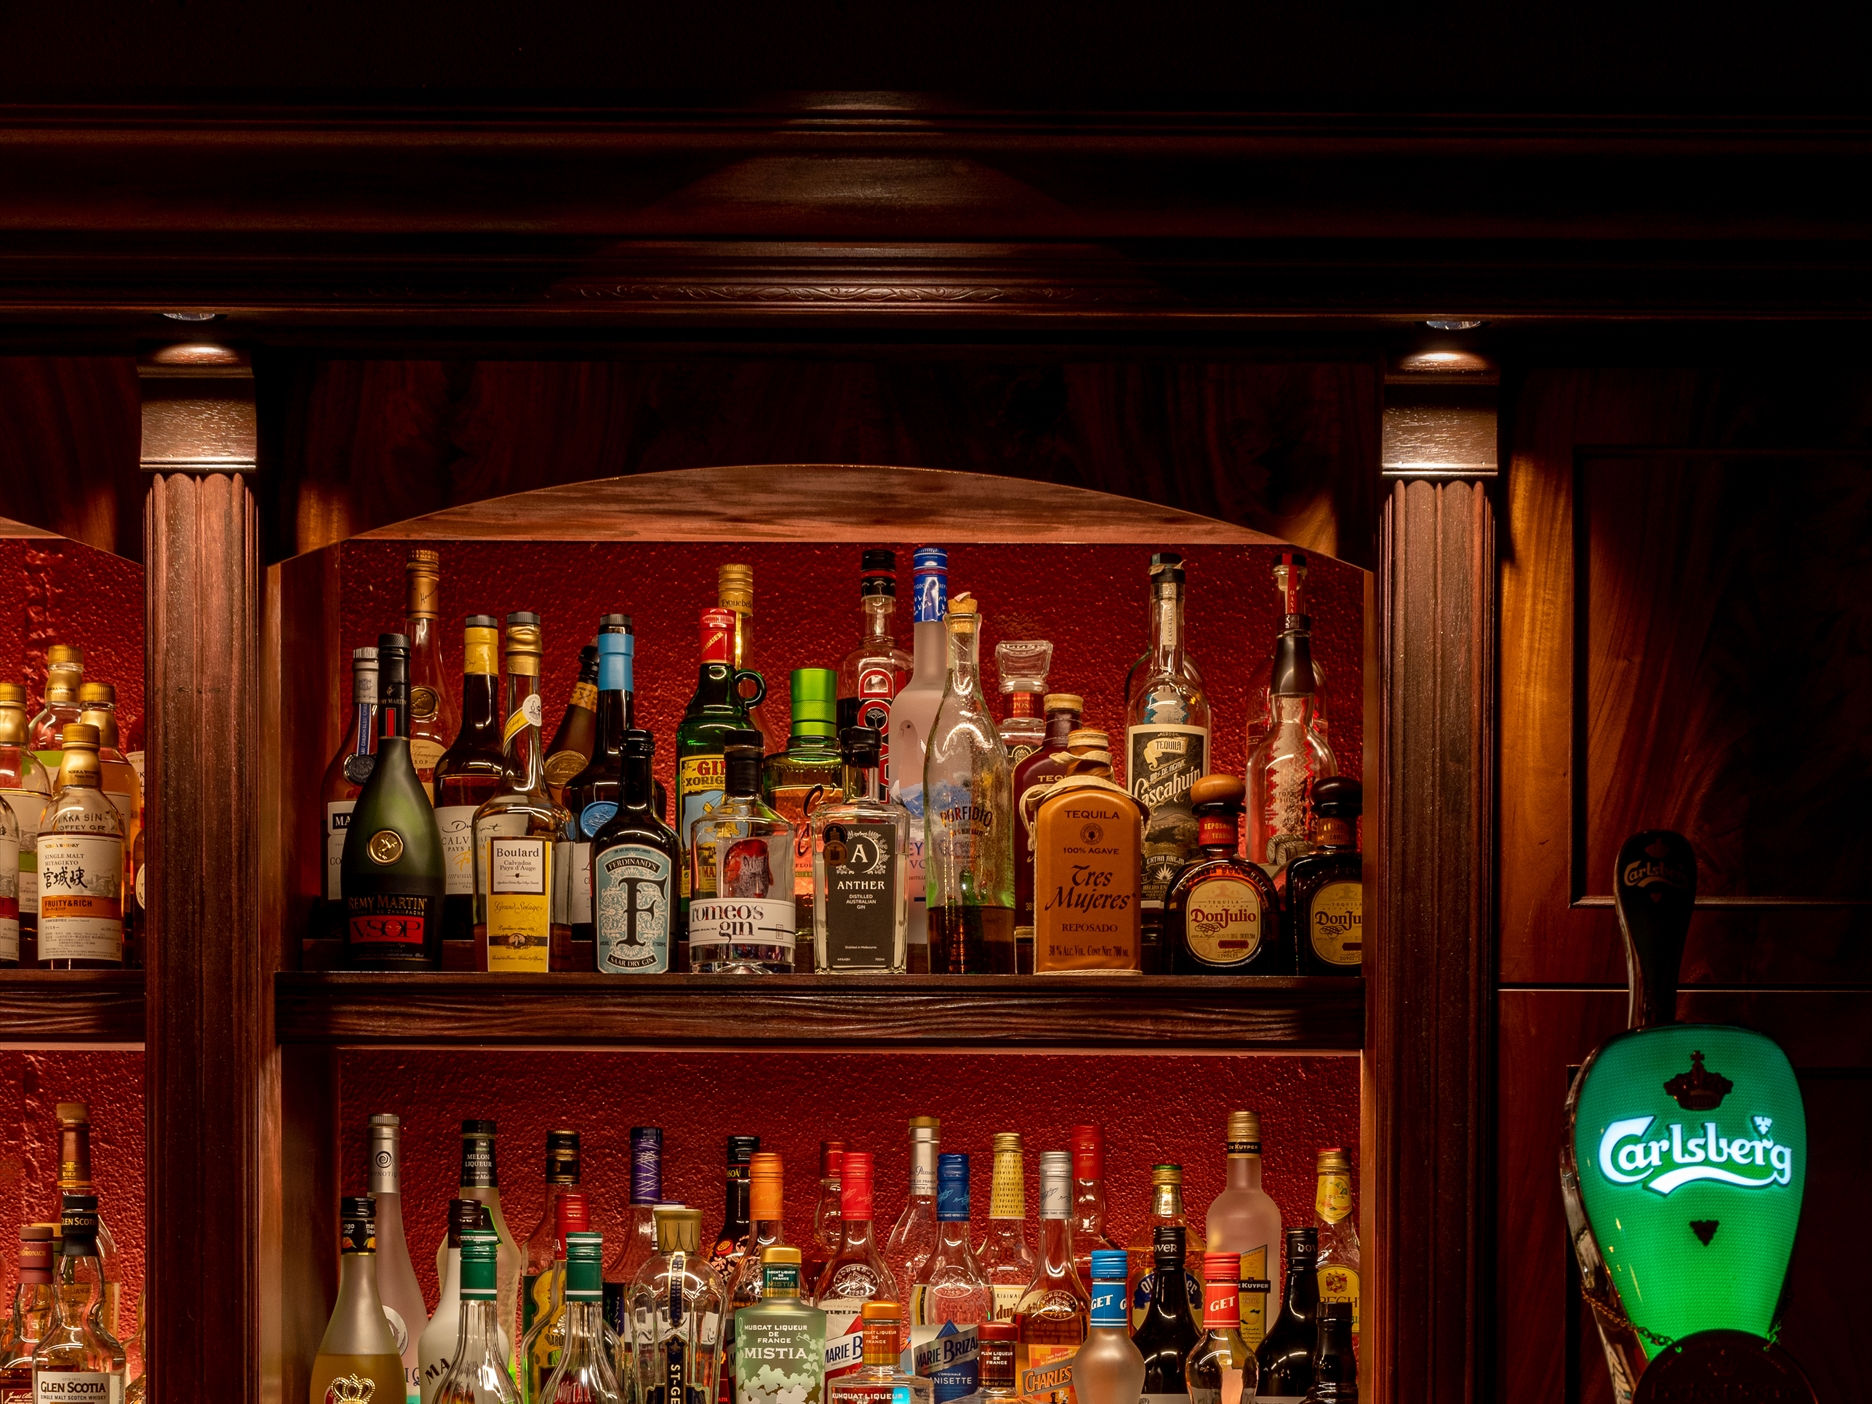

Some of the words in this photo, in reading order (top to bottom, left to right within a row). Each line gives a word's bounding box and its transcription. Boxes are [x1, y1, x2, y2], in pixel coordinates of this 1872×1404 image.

[1155, 740, 1182, 751] TEQUILA
[685, 776, 726, 787] XORIG
[1065, 810, 1120, 820] TEQUILA
[496, 848, 540, 858] Boulard
[1088, 847, 1120, 855] AGAVE
[608, 858, 658, 870] FERDINAND'S
[1070, 864, 1113, 887] Tres
[1624, 860, 1688, 888] Carlsberg
[837, 881, 886, 890] ANTHER
[377, 895, 426, 910] MARTIN
[1044, 886, 1131, 913] Mujeres
[616, 874, 668, 948] F
[691, 904, 765, 922] romeo's
[718, 921, 755, 943] gin
[1062, 923, 1118, 933] REPOSADO
[610, 956, 626, 965] SAAR
[627, 959, 641, 967] DRY
[641, 957, 654, 966] GIN
[1598, 1114, 1794, 1195] Carlsberg
[1091, 1294, 1113, 1310] GET
[1210, 1296, 1236, 1312] GET
[774, 1324, 808, 1332] LIQUEUR
[744, 1347, 808, 1360] MISTIA
[916, 1346, 943, 1368] MARIE
[944, 1334, 979, 1364] BRIZA
[1025, 1367, 1072, 1390] CHARLES
[41, 1381, 65, 1393] GLEN
[67, 1381, 106, 1393] SCOTIA
[864, 1392, 903, 1400] LIQUEUR
